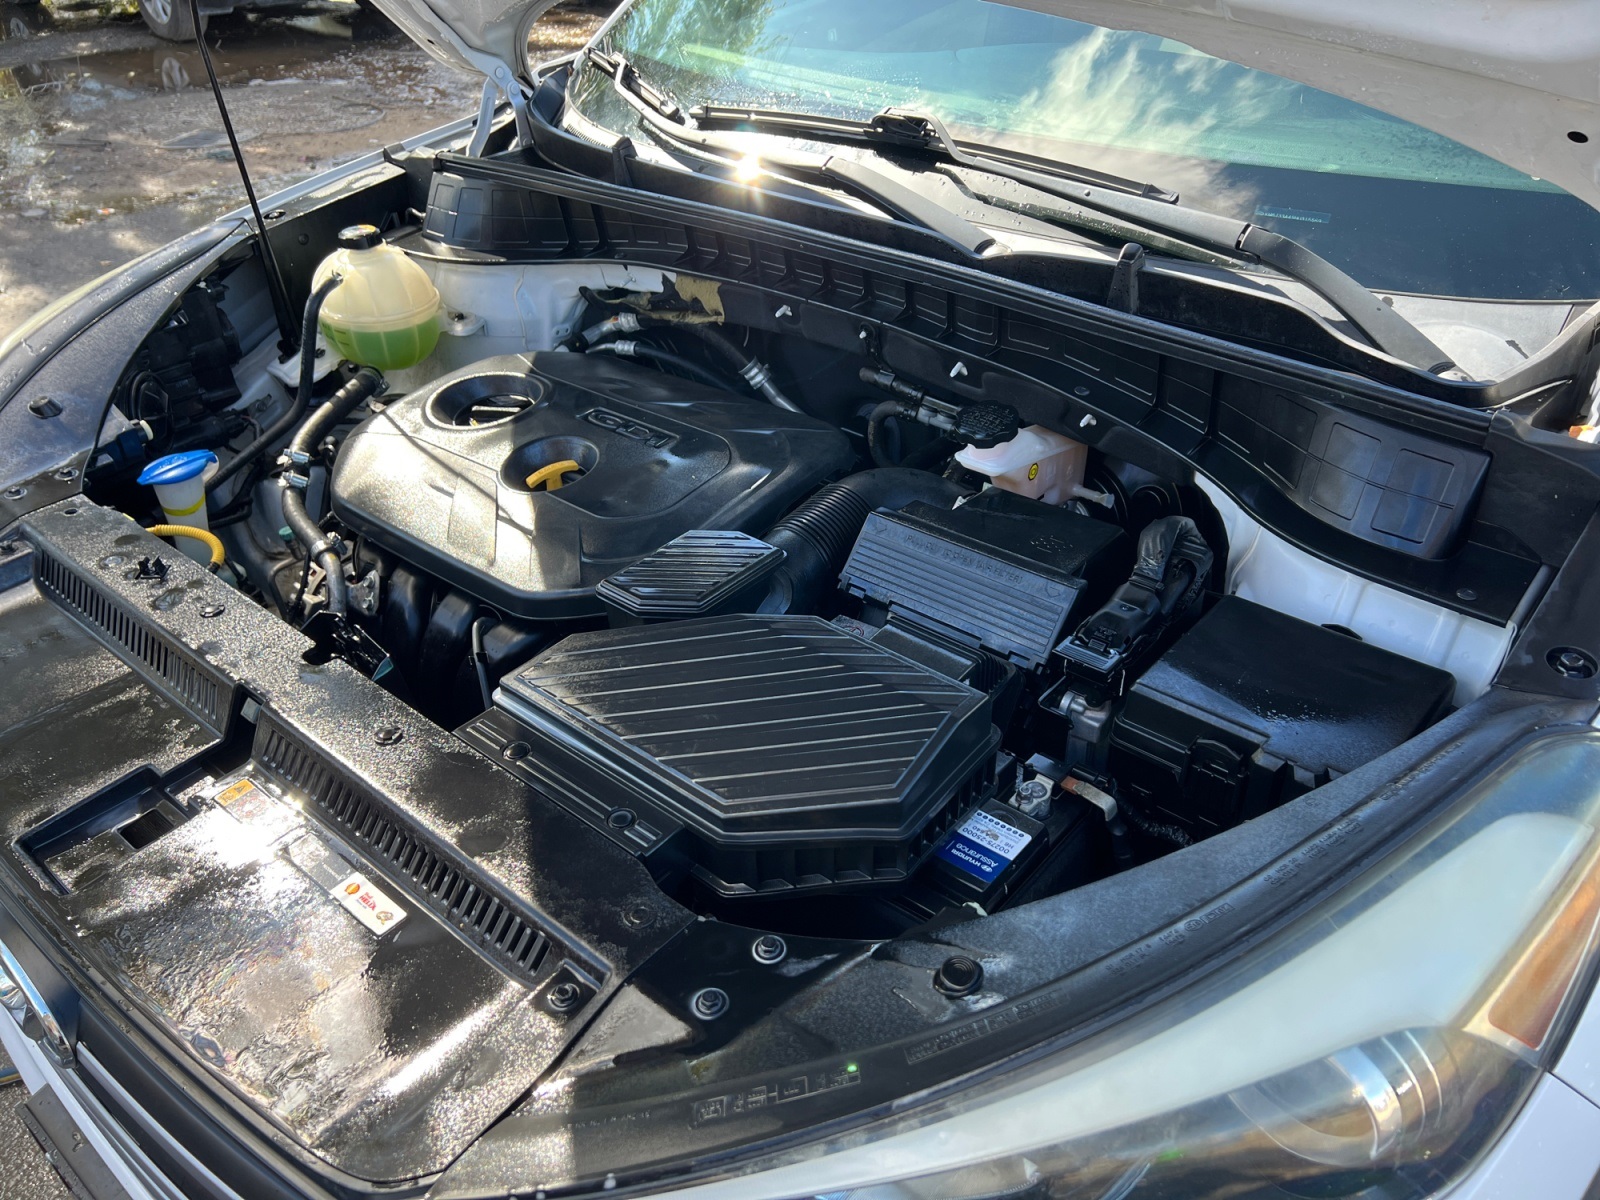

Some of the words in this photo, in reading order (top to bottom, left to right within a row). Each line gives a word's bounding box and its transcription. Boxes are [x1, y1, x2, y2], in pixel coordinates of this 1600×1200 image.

[587, 411, 670, 449] GDI
[962, 827, 1010, 854] 00275-25000
[951, 848, 982, 867] HYUNDAI
[955, 842, 999, 868] Assurance
